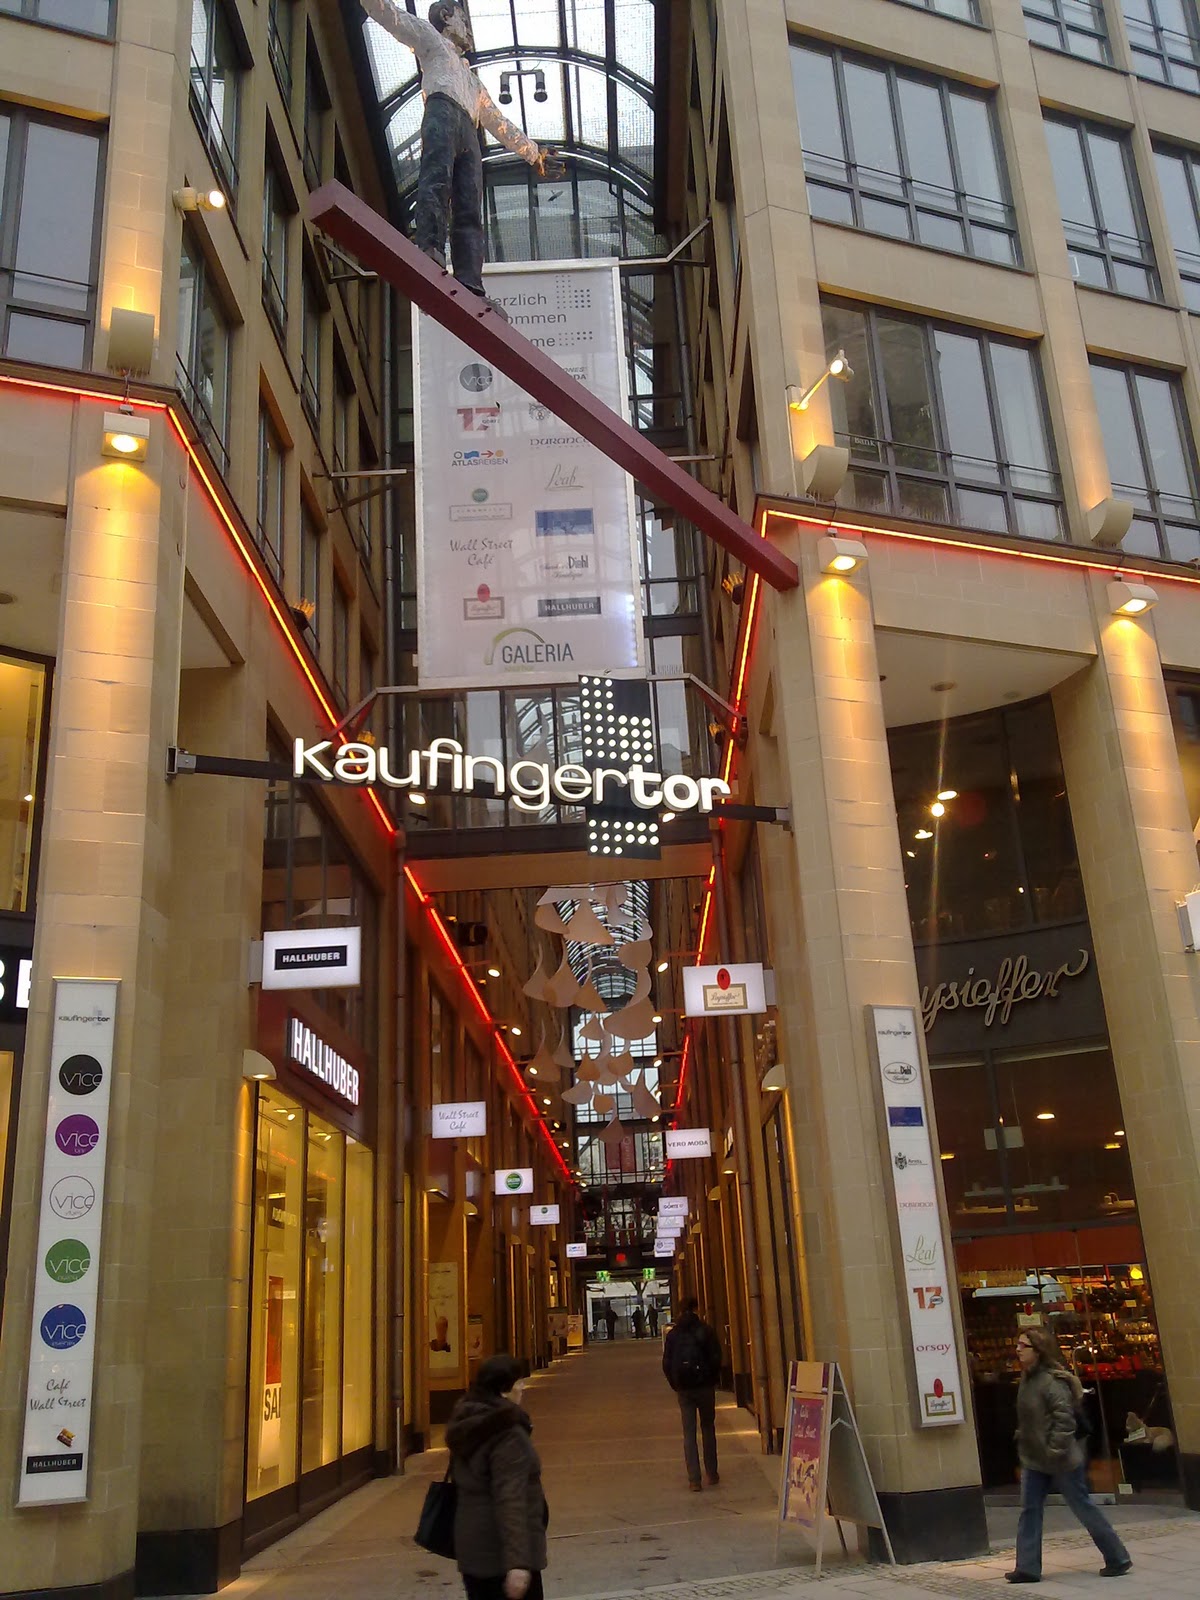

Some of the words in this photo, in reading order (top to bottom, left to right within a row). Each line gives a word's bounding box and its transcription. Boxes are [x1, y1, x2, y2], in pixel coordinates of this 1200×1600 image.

[487, 293, 547, 307] erzlich
[507, 313, 567, 325] ommen
[450, 539, 478, 552] Wall
[481, 537, 513, 550] Street
[544, 602, 595, 611] HALLHUBER
[502, 643, 574, 663] GALERIA
[282, 952, 341, 963] HALLHUBER
[921, 949, 1089, 1033] ysieffer
[291, 1018, 359, 1106] HALLHUBER
[916, 1343, 951, 1355] orsay
[30, 1398, 54, 1411] Wall
[33, 1457, 77, 1468] HALLHUBER
